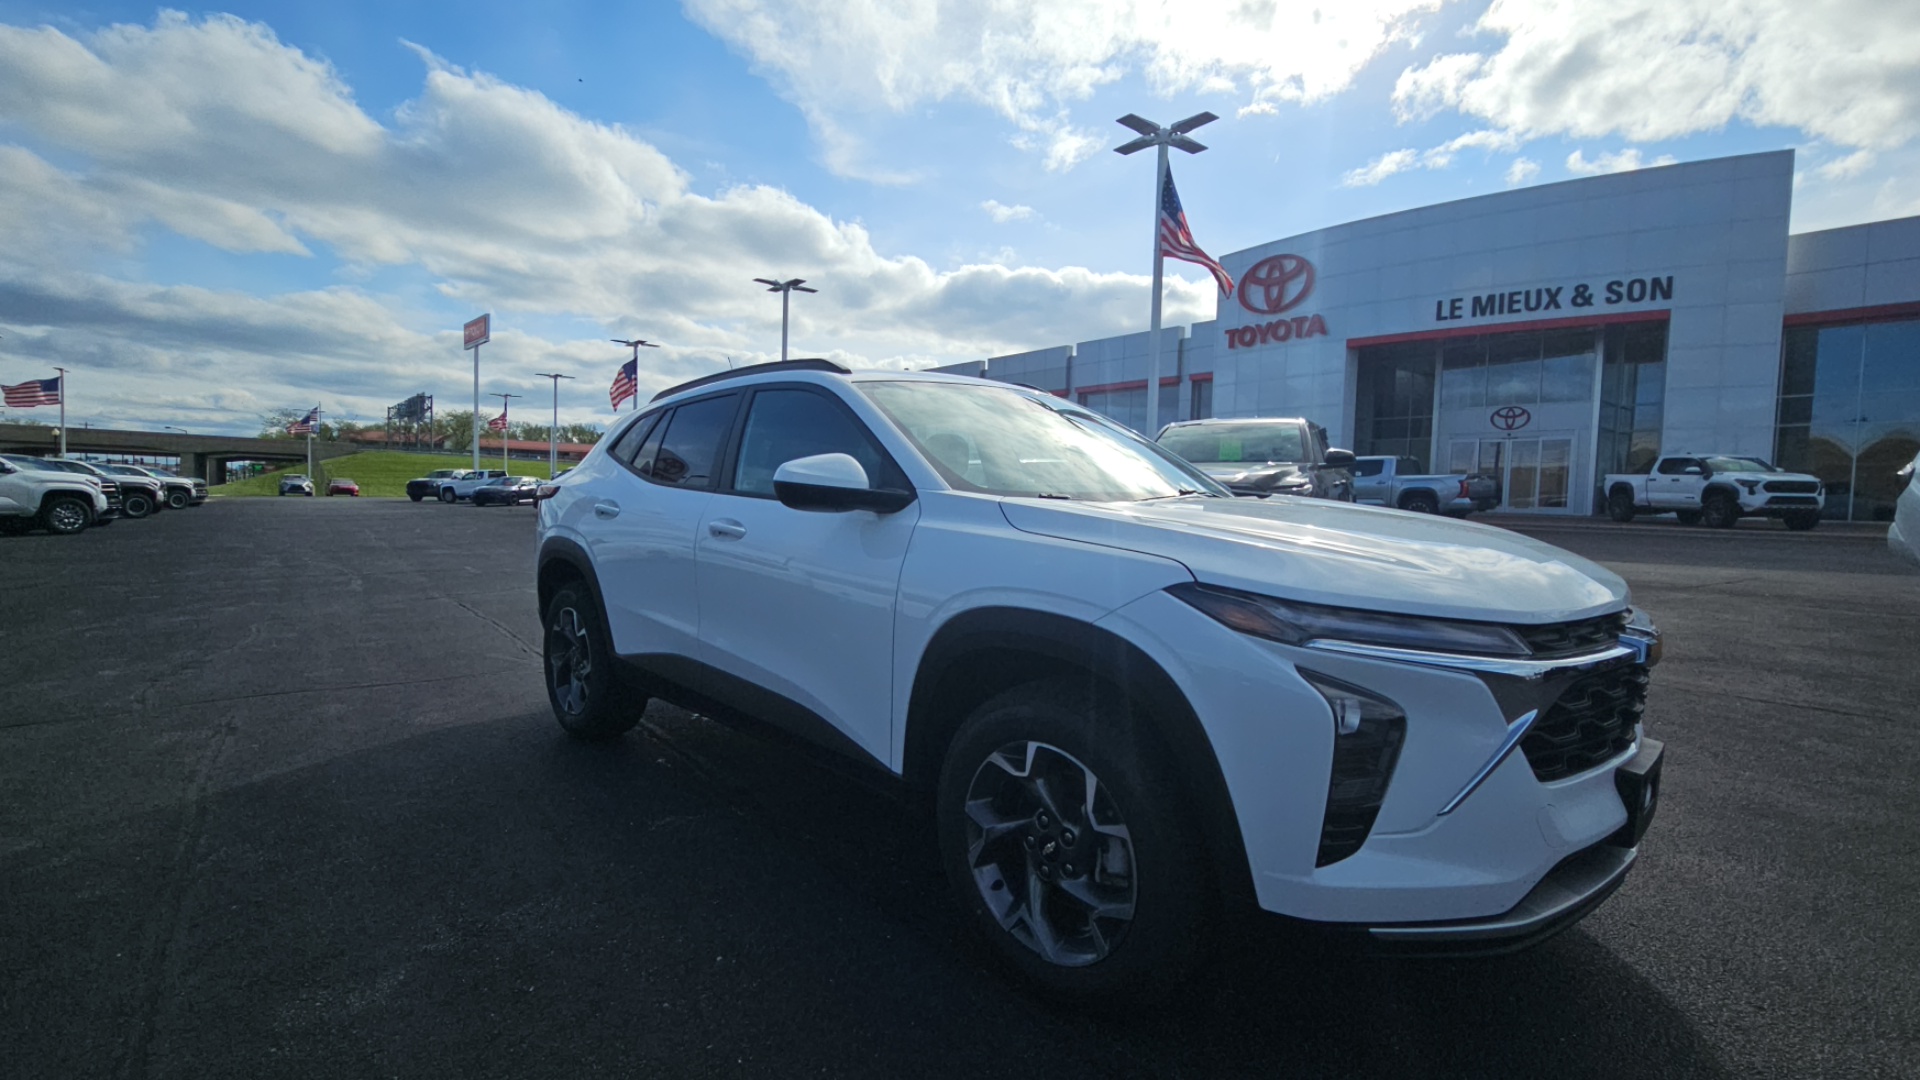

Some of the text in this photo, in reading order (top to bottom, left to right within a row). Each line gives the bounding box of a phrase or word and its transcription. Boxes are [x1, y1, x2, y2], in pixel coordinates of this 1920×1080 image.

[1436, 276, 1674, 321] LE MIEUX & SON
[1225, 313, 1328, 349] TOYOTA
